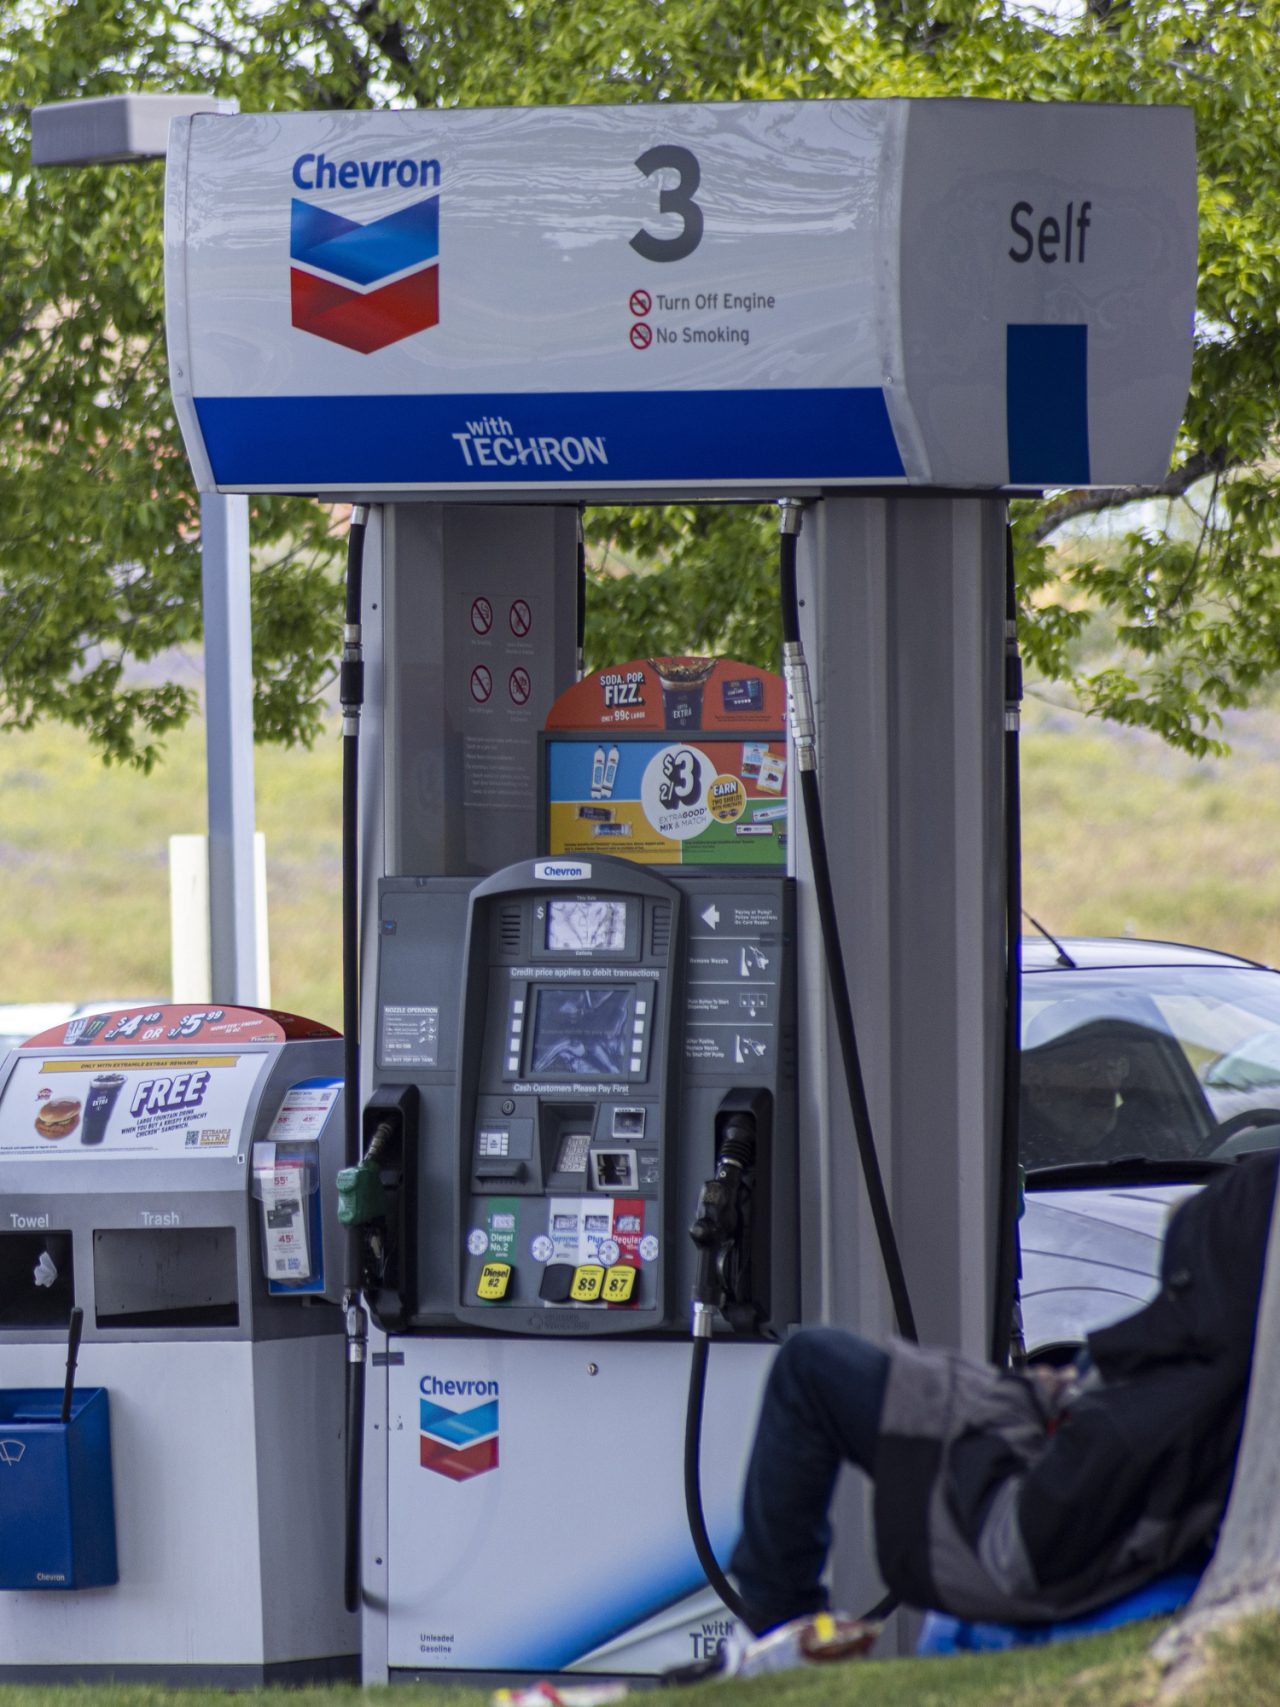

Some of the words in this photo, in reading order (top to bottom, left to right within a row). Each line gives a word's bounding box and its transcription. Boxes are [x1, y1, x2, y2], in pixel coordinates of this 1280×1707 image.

[292, 153, 441, 190] Chevron
[629, 144, 704, 263] 3
[1008, 201, 1092, 264] Self
[656, 294, 690, 310] Turn
[695, 293, 718, 310] Off
[724, 292, 776, 312] Engine
[656, 328, 678, 344] No
[683, 326, 750, 346] Smoking
[466, 416, 513, 436] with
[451, 433, 609, 471] TECHRON
[600, 674, 625, 686] SODA.
[626, 671, 644, 683] POP.
[605, 683, 644, 706] FIZZ.
[673, 707, 692, 719] EXTRA
[713, 781, 738, 797] EARN
[660, 822, 673, 832] MIX
[681, 817, 707, 826] MATCH
[544, 866, 582, 876] Chevron
[536, 906, 545, 920] $
[511, 968, 534, 976] Credit
[535, 968, 553, 978] price
[555, 968, 581, 978] applies
[583, 968, 591, 976] to
[592, 968, 612, 976] debit
[613, 968, 660, 977] transactions
[142, 1026, 164, 1040] OR
[130, 1070, 211, 1118] FREE
[513, 1083, 531, 1092] Cash
[533, 1083, 572, 1093] Customers
[573, 1083, 597, 1092] Please
[598, 1083, 611, 1094] Pay
[612, 1083, 629, 1093] First
[121, 1126, 136, 1135] WHEN
[137, 1124, 148, 1132] YOU
[148, 1122, 158, 1130] BUY
[164, 1118, 183, 1126] KRISPY
[183, 1112, 208, 1122] KRUNCHY
[136, 1116, 152, 1125] LARGE
[153, 1112, 179, 1122] FOUNTAIN
[10, 1213, 50, 1228] Towel
[141, 1211, 180, 1226] Trash
[490, 1233, 513, 1242] Diesel
[587, 1235, 604, 1243] Plus
[612, 1235, 642, 1245] Regular
[490, 1243, 509, 1251] No.2
[483, 1268, 510, 1278] Diesel
[488, 1278, 500, 1288] #2
[578, 1278, 597, 1292] 89
[609, 1278, 628, 1292] 87
[419, 1375, 499, 1396] Chevron
[36, 1573, 65, 1582] Chevron
[702, 1620, 734, 1636] with
[420, 1632, 455, 1642] Unleaded
[420, 1644, 452, 1653] Gasoline
